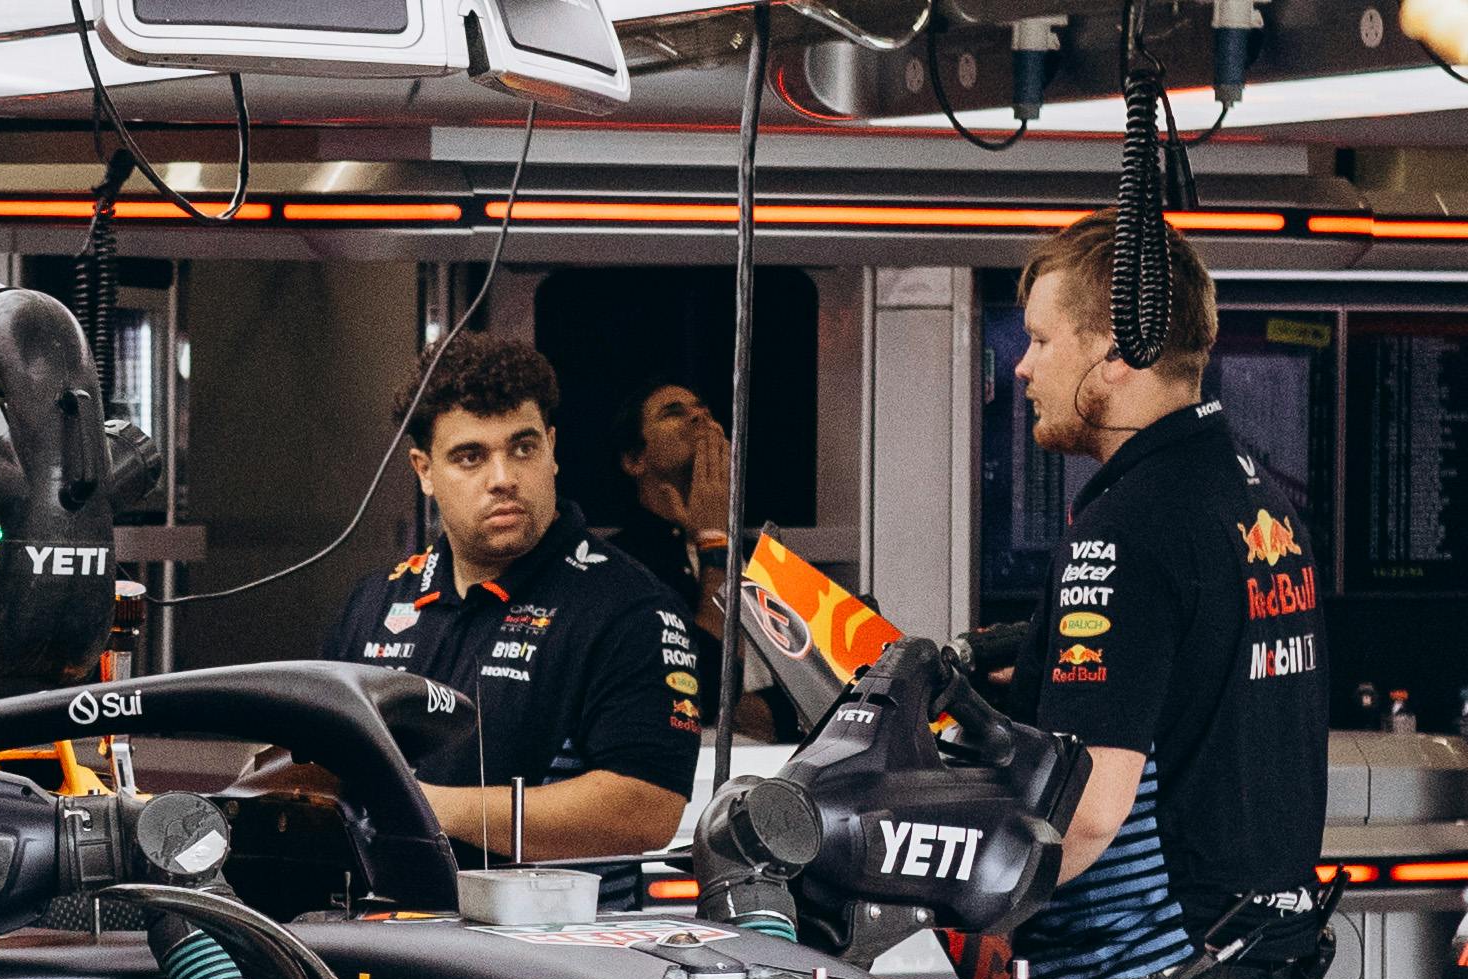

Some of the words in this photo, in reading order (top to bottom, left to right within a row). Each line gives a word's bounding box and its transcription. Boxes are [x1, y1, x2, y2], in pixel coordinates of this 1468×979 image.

[25, 546, 109, 576] YETI
[1070, 540, 1116, 561] VISA
[1061, 562, 1117, 583] telcel
[1060, 586, 1114, 607] ROKT
[1249, 636, 1303, 680] Mobil
[480, 666, 531, 681] HONDA
[102, 690, 143, 719] Sui
[836, 709, 875, 724] YETI
[879, 820, 980, 881] YETI
